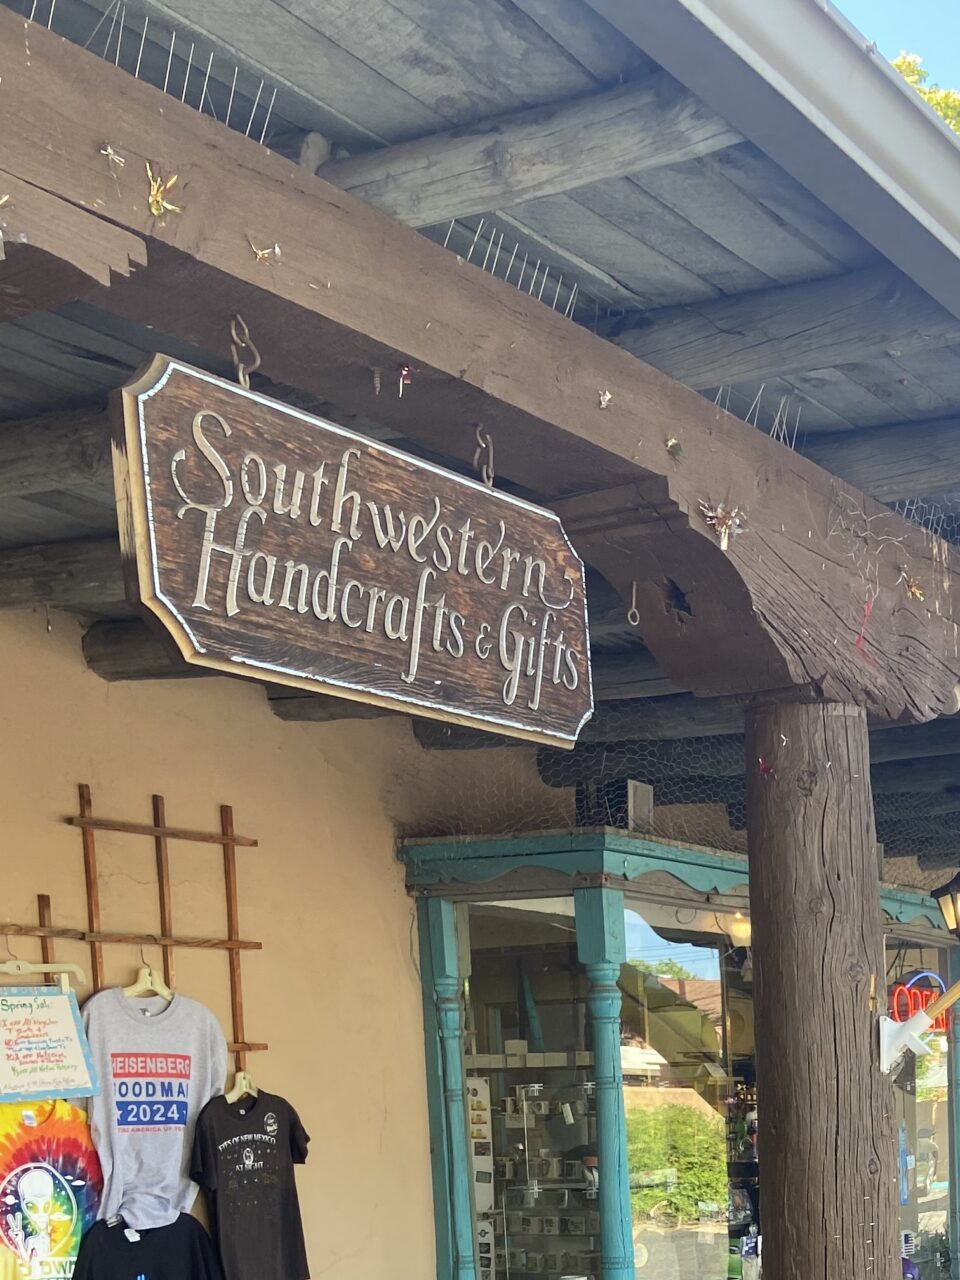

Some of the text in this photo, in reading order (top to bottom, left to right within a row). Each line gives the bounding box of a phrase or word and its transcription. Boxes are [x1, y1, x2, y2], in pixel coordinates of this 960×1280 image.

[171, 409, 575, 609] Southwestern
[177, 504, 578, 711] Handcrafts & Gifts
[0, 998, 33, 1016] Spring
[113, 1081, 189, 1098] OODMA
[127, 1103, 180, 1122] 2024
[240, 1134, 254, 1142] NEW
[253, 1133, 276, 1145] MEXICO
